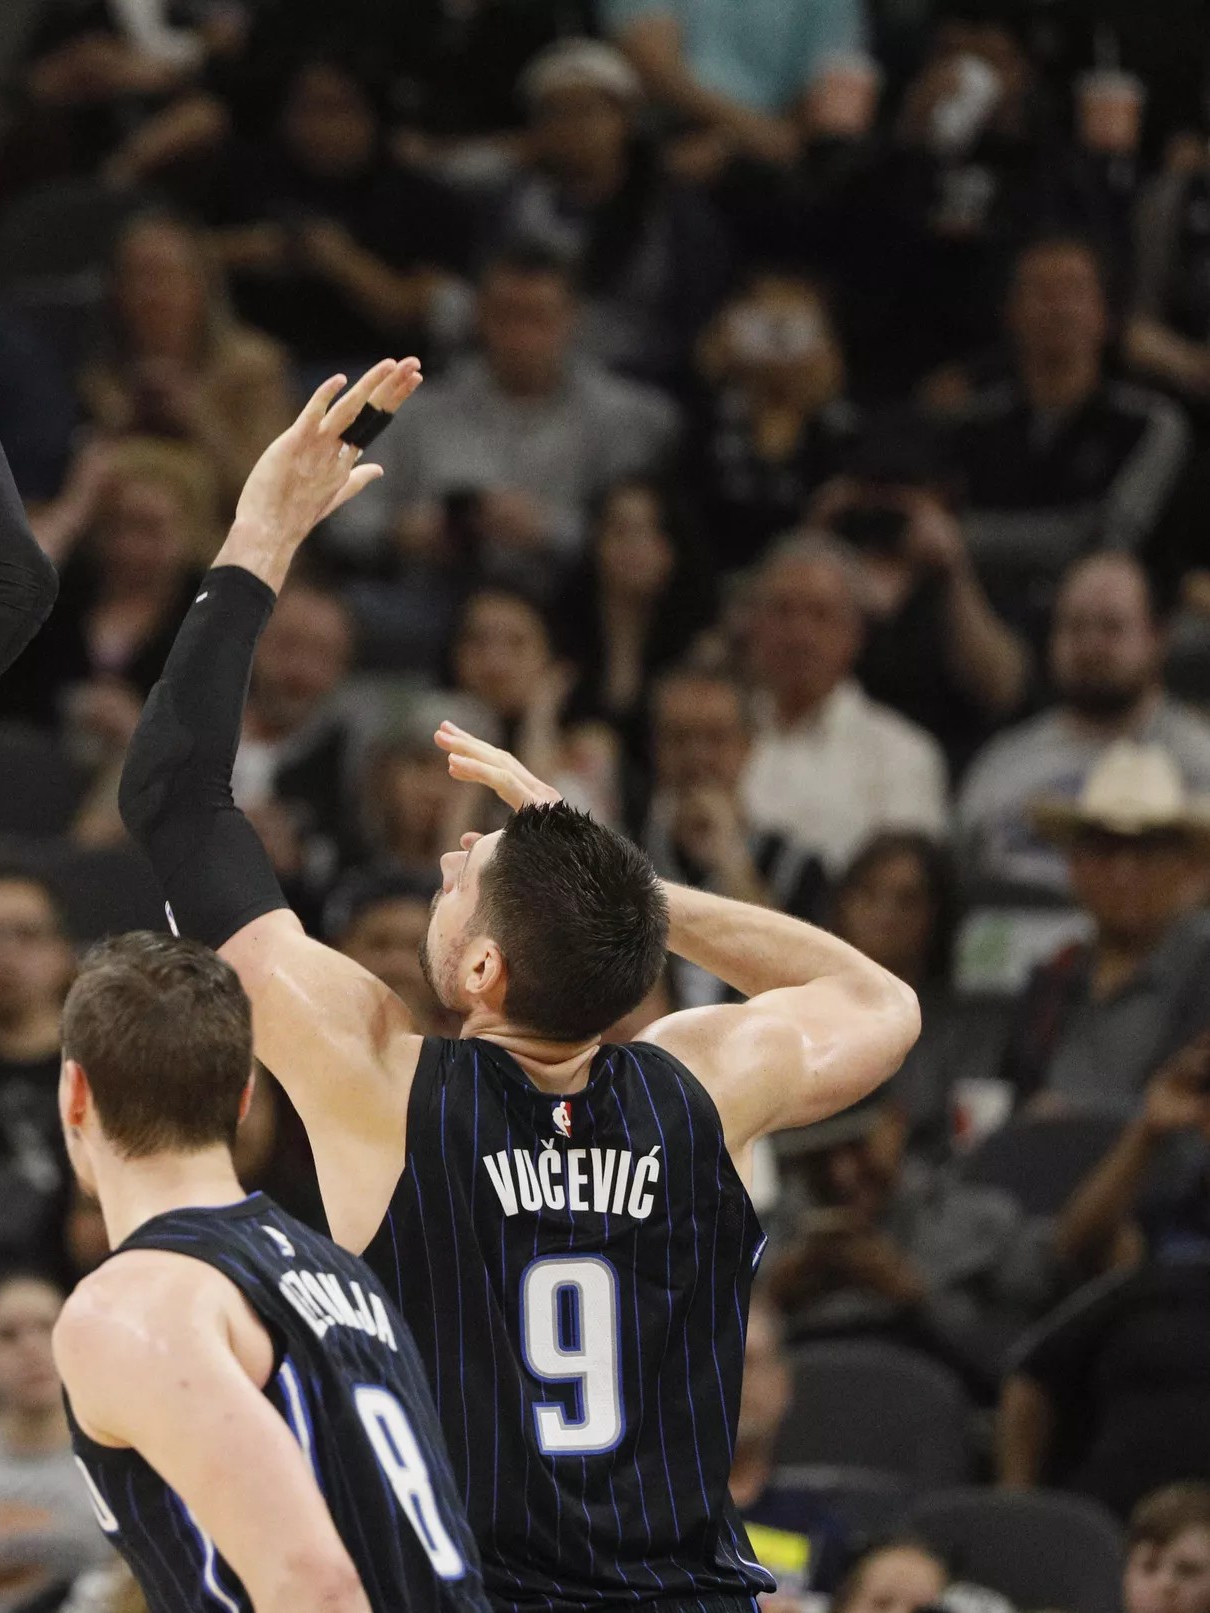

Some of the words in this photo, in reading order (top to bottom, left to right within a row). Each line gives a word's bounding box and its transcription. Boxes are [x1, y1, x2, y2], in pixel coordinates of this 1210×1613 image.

[483, 1138, 661, 1219] VUČEVIĆ
[520, 1252, 626, 1456] 9
[354, 1384, 465, 1580] 8
